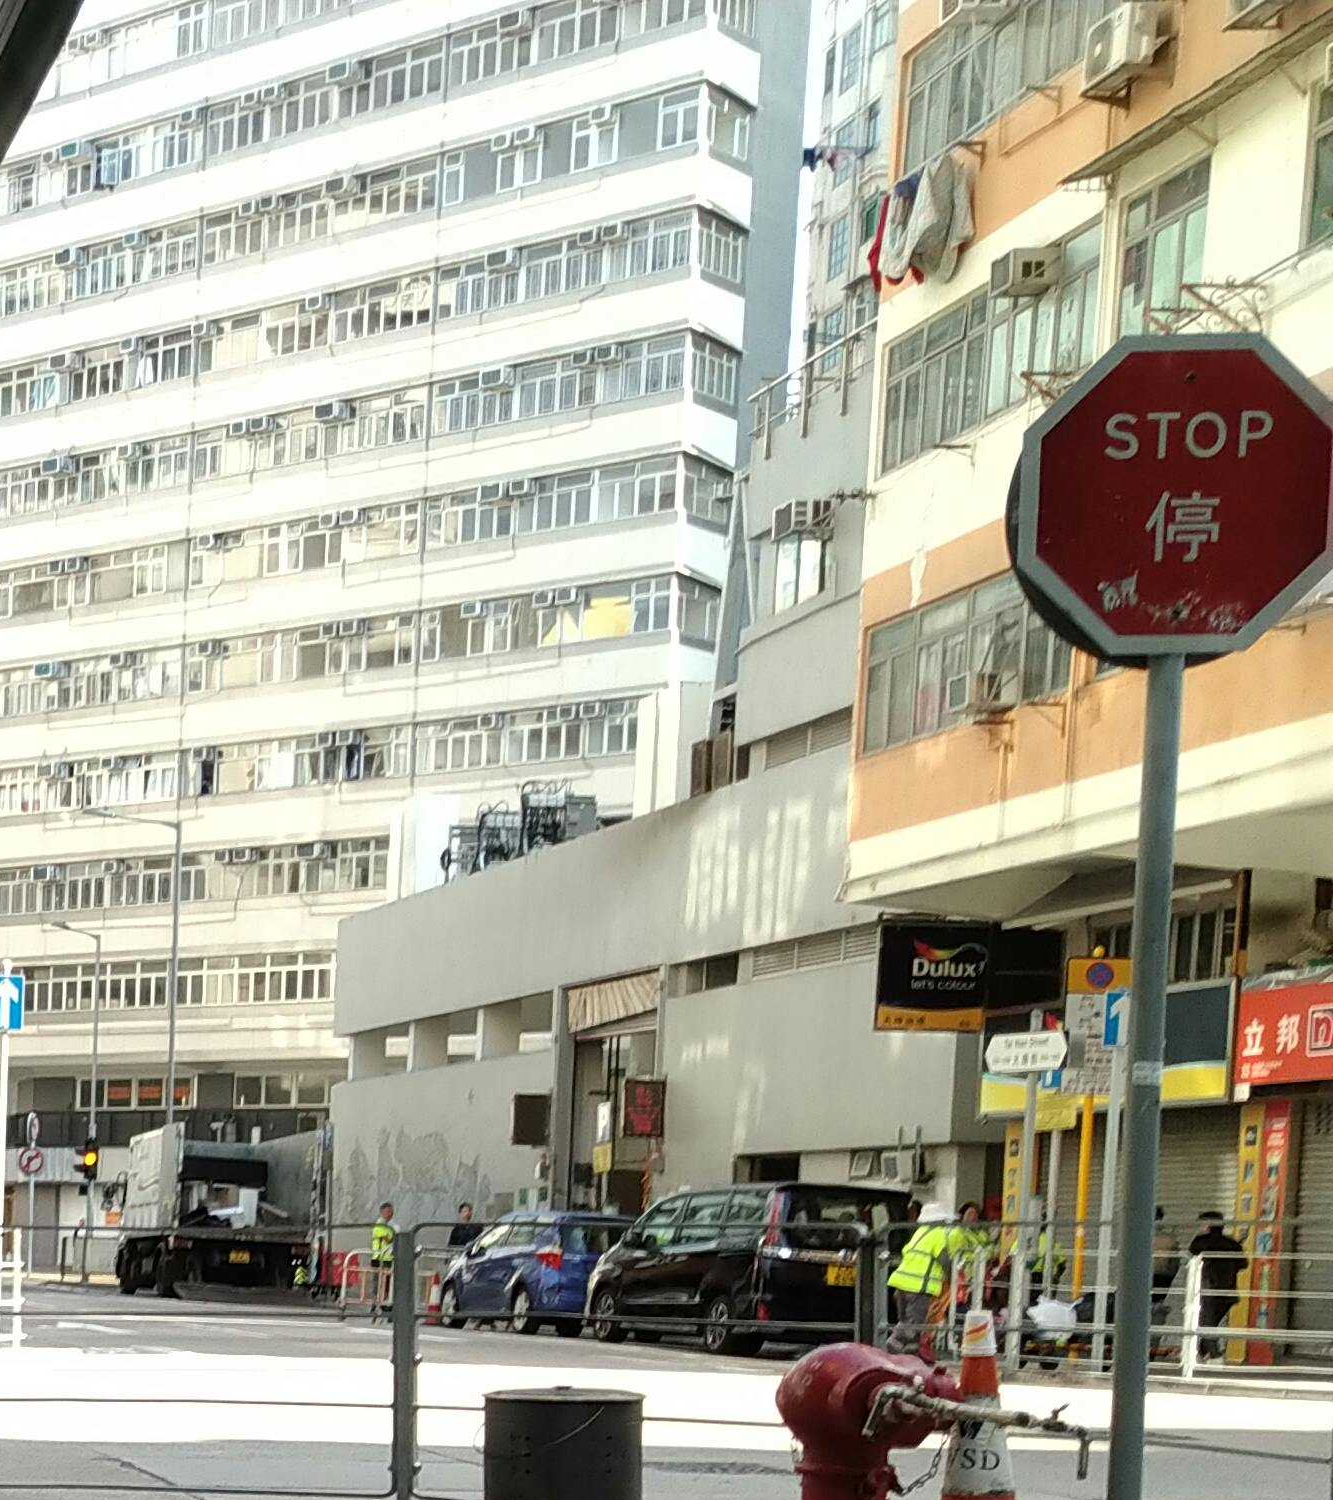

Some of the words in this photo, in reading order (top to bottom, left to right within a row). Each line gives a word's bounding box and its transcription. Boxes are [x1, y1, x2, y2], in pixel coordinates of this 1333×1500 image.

[1104, 410, 1274, 460] STOP
[1145, 490, 1220, 562] 停
[912, 957, 977, 978] Dulux
[1242, 1014, 1301, 1057] 立邦
[950, 1448, 1000, 1471] SD
